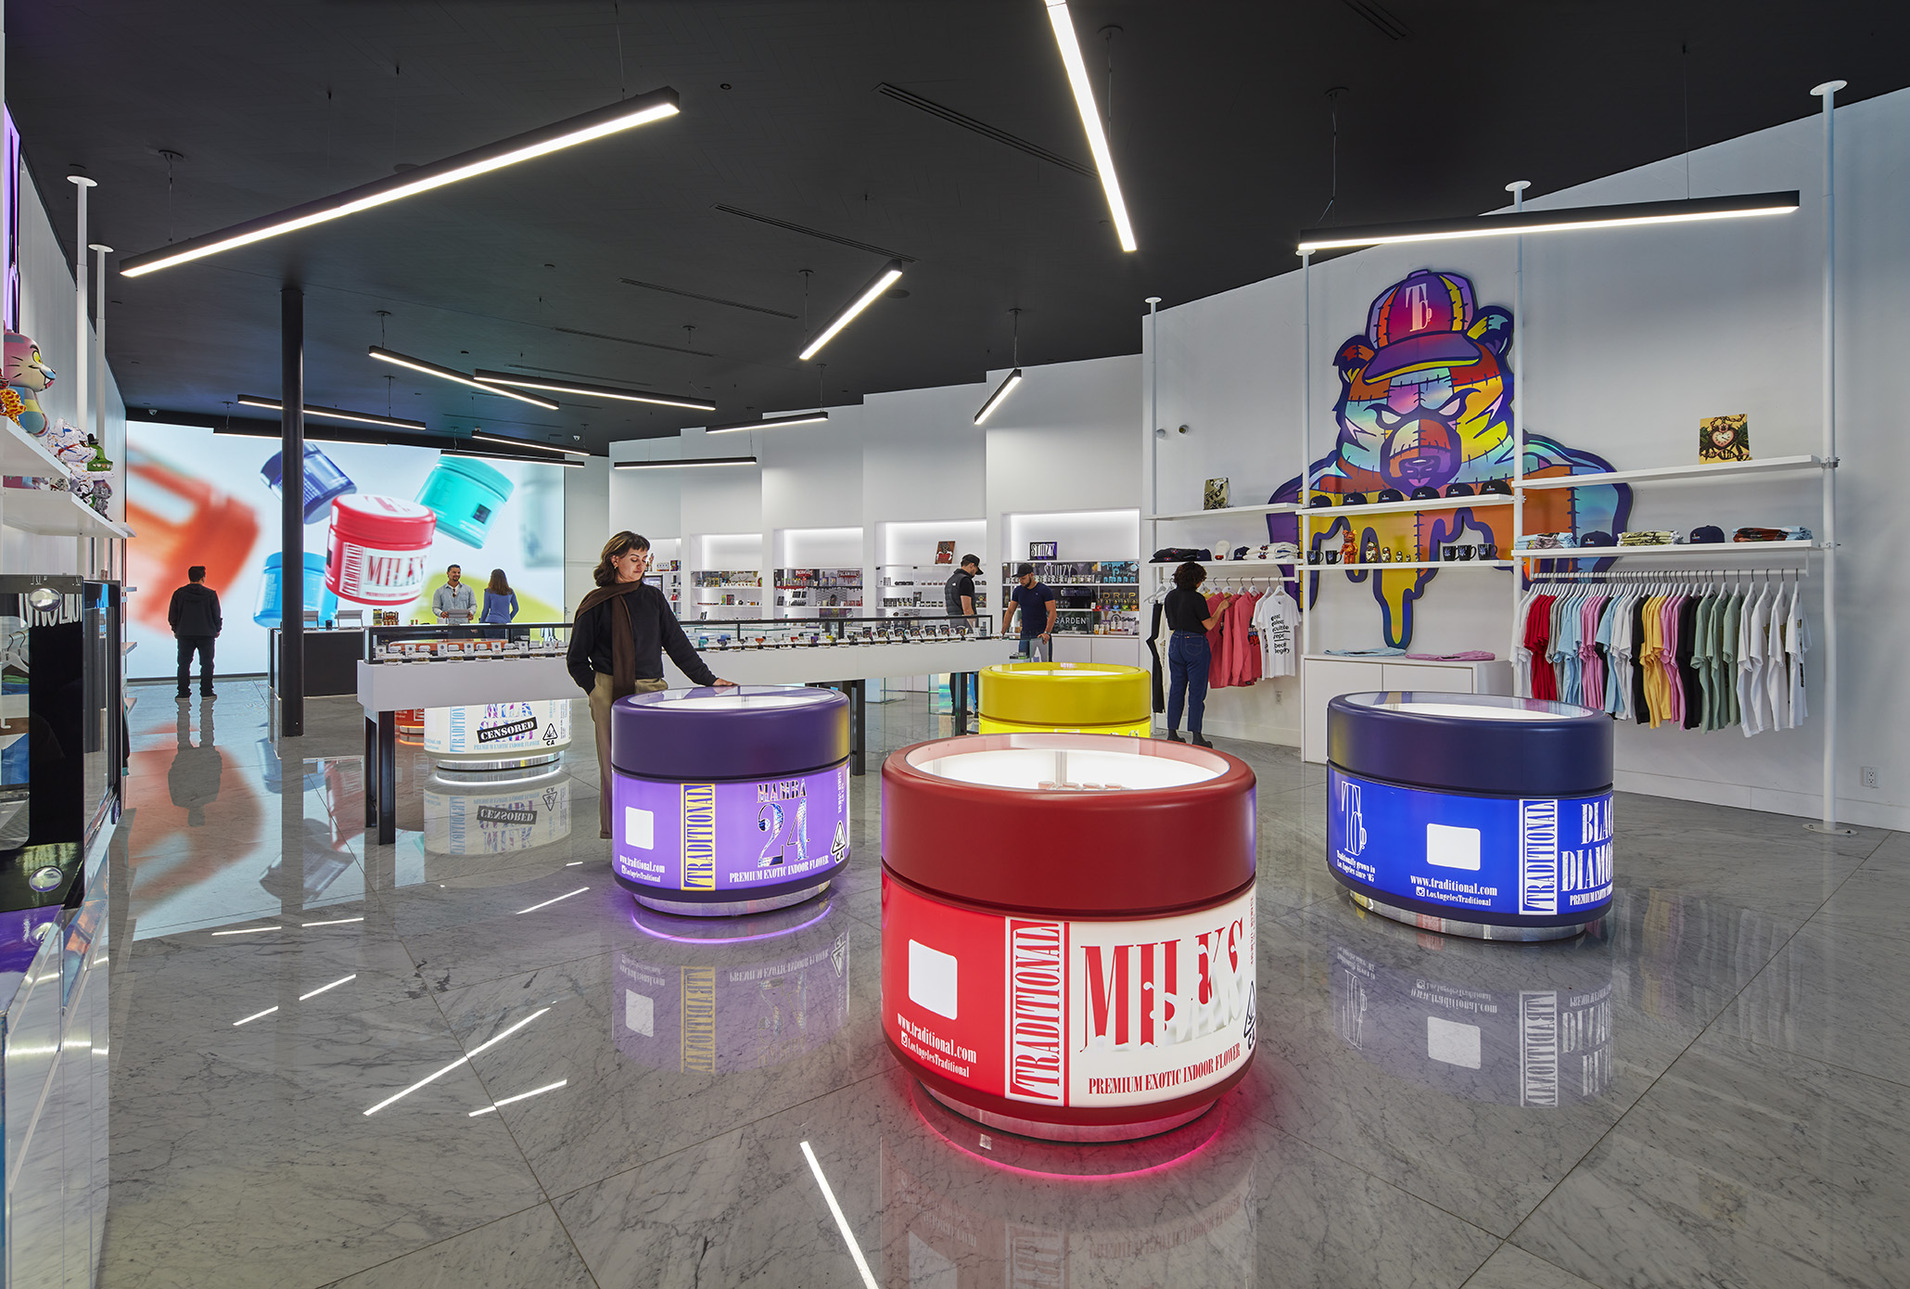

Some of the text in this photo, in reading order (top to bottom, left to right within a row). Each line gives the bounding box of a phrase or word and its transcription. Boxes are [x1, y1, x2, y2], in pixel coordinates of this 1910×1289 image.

[1055, 617, 1087, 625] GARDEN
[480, 720, 535, 742] CENSORED
[757, 778, 808, 804] MAMBA
[684, 785, 714, 889] TRADITIONAL
[757, 798, 810, 868] 24
[729, 854, 829, 883] PREMIUM EXOTIC INDOOR FLOWER
[834, 850, 844, 863] CA
[1523, 801, 1555, 912] TRADITIONAL
[1561, 840, 1613, 892] DIAMO
[1410, 875, 1498, 896] www.traditional.com
[1426, 889, 1492, 907] LosAngelesTraditional
[1012, 922, 1061, 1100] TRADITIONAL
[897, 1012, 977, 1064] www.traditional.com
[908, 1037, 970, 1078] LosAngelesTraditional
[1088, 1042, 1241, 1095] PREMIUM EXOTIC INDOOR FLOWER
